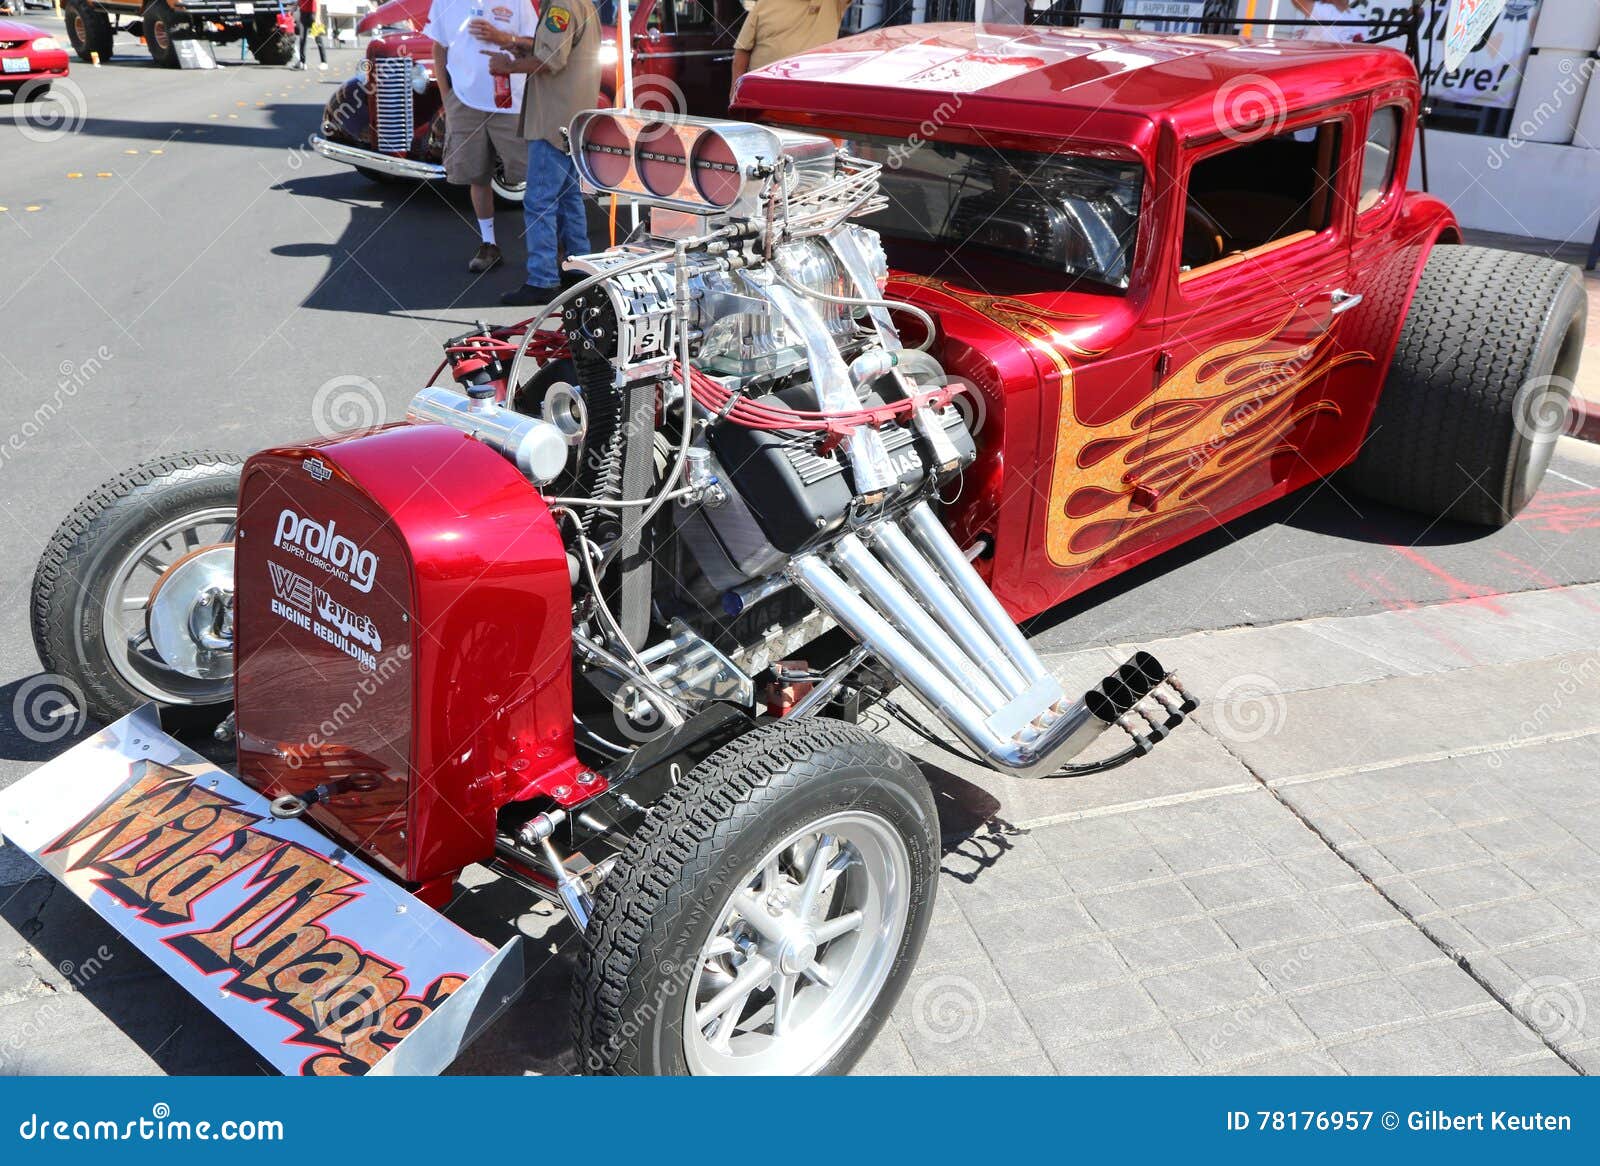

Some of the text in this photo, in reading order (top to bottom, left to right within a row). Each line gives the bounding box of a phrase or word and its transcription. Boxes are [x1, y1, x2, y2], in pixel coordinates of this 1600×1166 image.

[273, 509, 378, 594] prolong
[281, 541, 349, 582] SUPER LUBRICANTS
[271, 598, 377, 671] ENGINE REBUILDING
[314, 586, 382, 652] Wayne's
[42, 759, 286, 925] Wild
[673, 854, 740, 947] NANKANG
